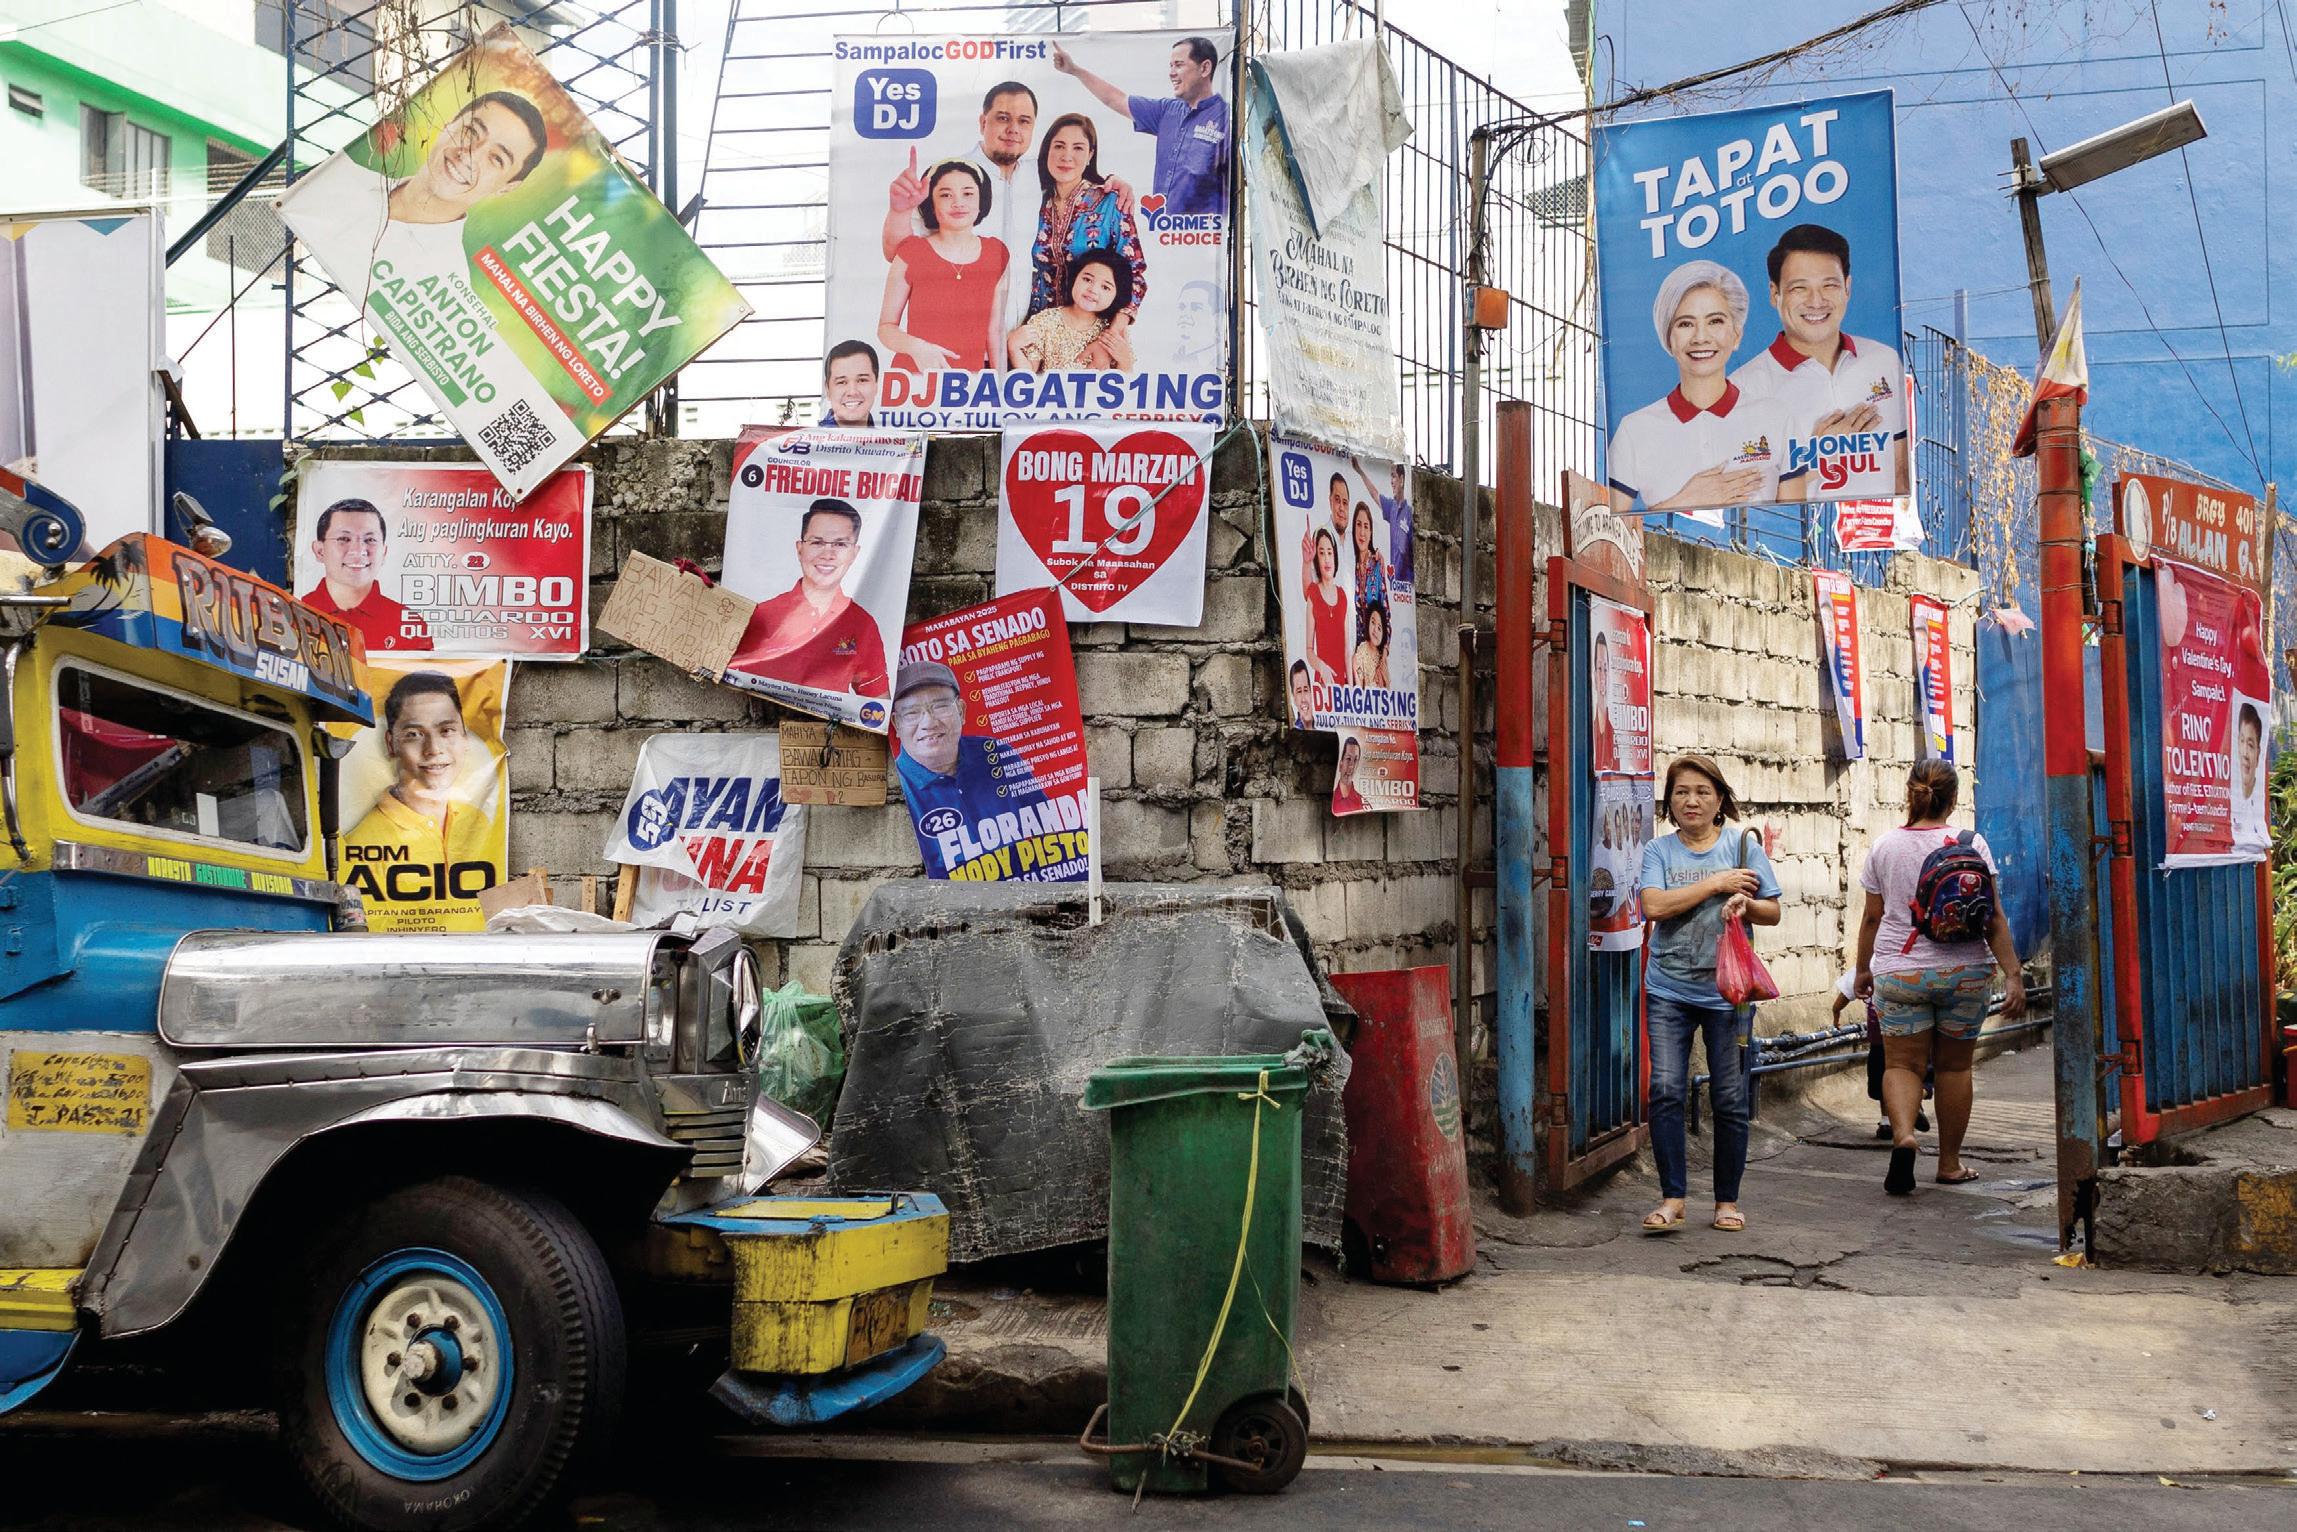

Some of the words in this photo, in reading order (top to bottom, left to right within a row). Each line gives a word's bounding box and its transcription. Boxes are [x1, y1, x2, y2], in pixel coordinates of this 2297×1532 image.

[866, 77, 922, 101] Yes
[872, 104, 921, 130] DJ
[1633, 110, 1840, 214] TAPAT
[1736, 171, 1751, 187] at
[1144, 210, 1222, 232] YORME'S
[1640, 160, 1848, 259] TOTOO
[1159, 232, 1222, 245] CHOICE
[1286, 226, 1339, 271] MAHAL
[1342, 255, 1354, 276] NA
[544, 195, 682, 338] HAPPY
[1270, 249, 1318, 297] BIRHEN
[1320, 278, 1336, 303] NG
[1340, 279, 1386, 317] LORETO
[447, 272, 498, 331] KONSEHAL
[502, 222, 646, 380] FIESTA!
[417, 275, 494, 358] ANTON
[480, 253, 515, 298] MAHAL
[513, 290, 529, 312] NA
[525, 302, 560, 346] BIRHEN
[555, 340, 572, 361] NG
[568, 355, 604, 398] LORETO
[371, 260, 497, 404] CAPISTRANO
[383, 310, 406, 332] BIDA
[398, 328, 420, 349] ANG
[412, 346, 451, 385] SERBISYO
[816, 444, 852, 454] Distrito
[1789, 432, 1890, 471] HONEY
[748, 470, 756, 482] 6
[765, 464, 851, 497] FREDDIE
[1018, 451, 1083, 481] BONG
[1091, 452, 1197, 485] MARZAN
[1285, 459, 1307, 479] Yes
[402, 488, 496, 512] Karangalan
[1289, 479, 1308, 501] DJ
[1051, 484, 1156, 556] 19
[2196, 493, 2225, 528] BRGY
[2236, 505, 2254, 535] 401
[397, 519, 427, 541] Ang
[431, 519, 529, 543] paglingkuran
[533, 520, 573, 543] Kayo.
[2178, 519, 2228, 572] ALLAN
[403, 553, 457, 569] ATTY.
[466, 555, 485, 568] 22
[1047, 558, 1078, 567] Subok
[622, 557, 707, 616] BAWAL
[1071, 583, 1114, 591] DISTRITO
[1118, 584, 1128, 592] IV
[1094, 571, 1107, 579] sa
[401, 574, 574, 608] BIMBO
[171, 550, 359, 708] RUBEN
[401, 610, 575, 625] EDUARDO
[924, 612, 976, 633] MAKABAYAN
[975, 606, 998, 616] 2025
[400, 625, 509, 640] QUINTOS
[529, 626, 572, 640] XVI
[945, 631, 970, 656] SA
[972, 607, 1046, 647] SENADO
[2196, 621, 2217, 647] Happy
[947, 654, 966, 666] PARA
[965, 650, 977, 660] SA
[975, 643, 1009, 656] BYAHENG
[1008, 630, 1050, 646] PAGBABAGO
[2182, 647, 2220, 671] Valentine's
[254, 649, 309, 692] SUSAN
[1610, 704, 1647, 732] BIMBO
[781, 727, 816, 740] MAHIYA
[782, 749, 819, 767] BAWA
[782, 769, 826, 786] TAPON
[832, 771, 853, 788] NG
[1360, 778, 1415, 797] BIMBO
[661, 777, 789, 832] AYAN
[345, 845, 409, 862] ROM
[345, 860, 496, 902] ACIO
[400, 908, 417, 916] NG
[418, 907, 481, 915] BARANGAY
[702, 898, 752, 915] LIST
